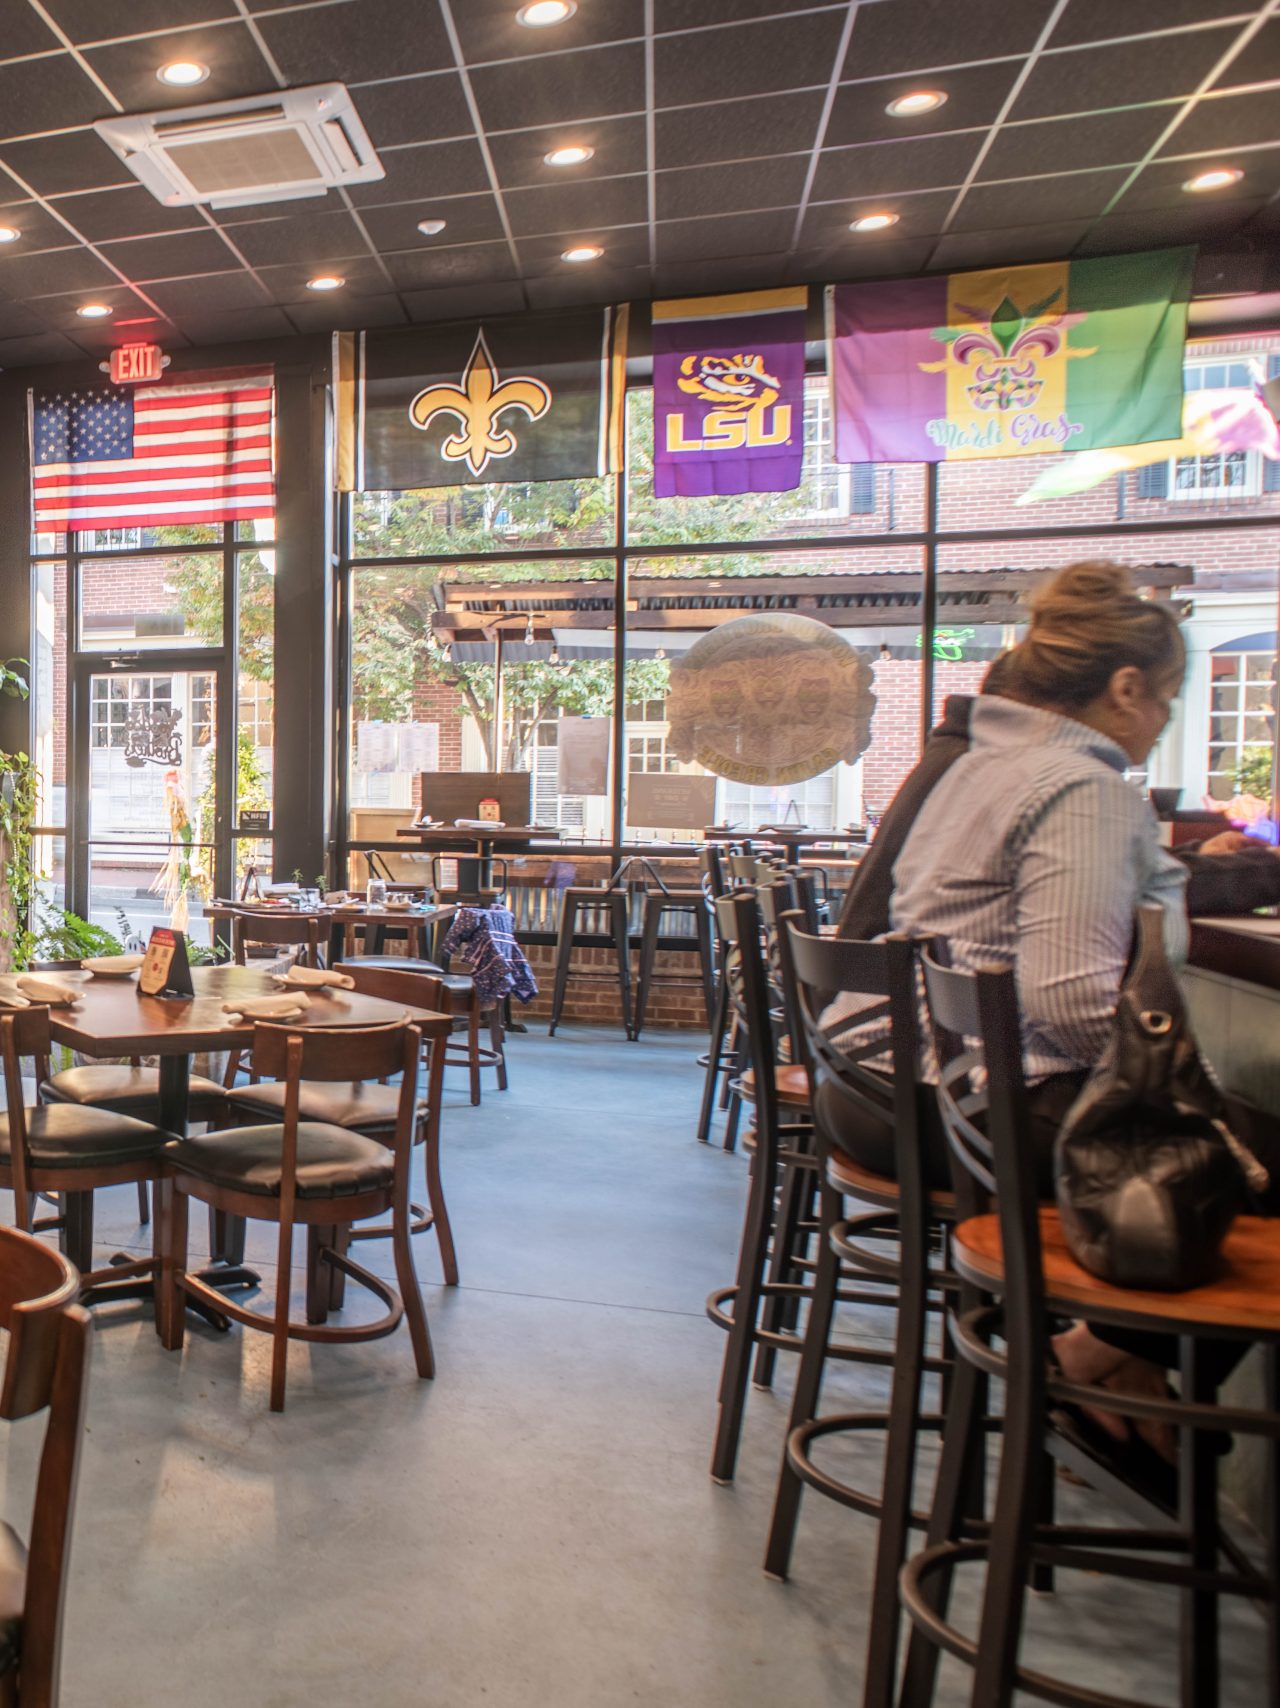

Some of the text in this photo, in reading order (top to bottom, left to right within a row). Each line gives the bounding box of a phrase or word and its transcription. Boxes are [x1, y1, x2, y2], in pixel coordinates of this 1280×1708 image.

[118, 346, 155, 379] EXIT
[666, 404, 793, 453] LSU
[926, 412, 1084, 449] Mardi Gras
